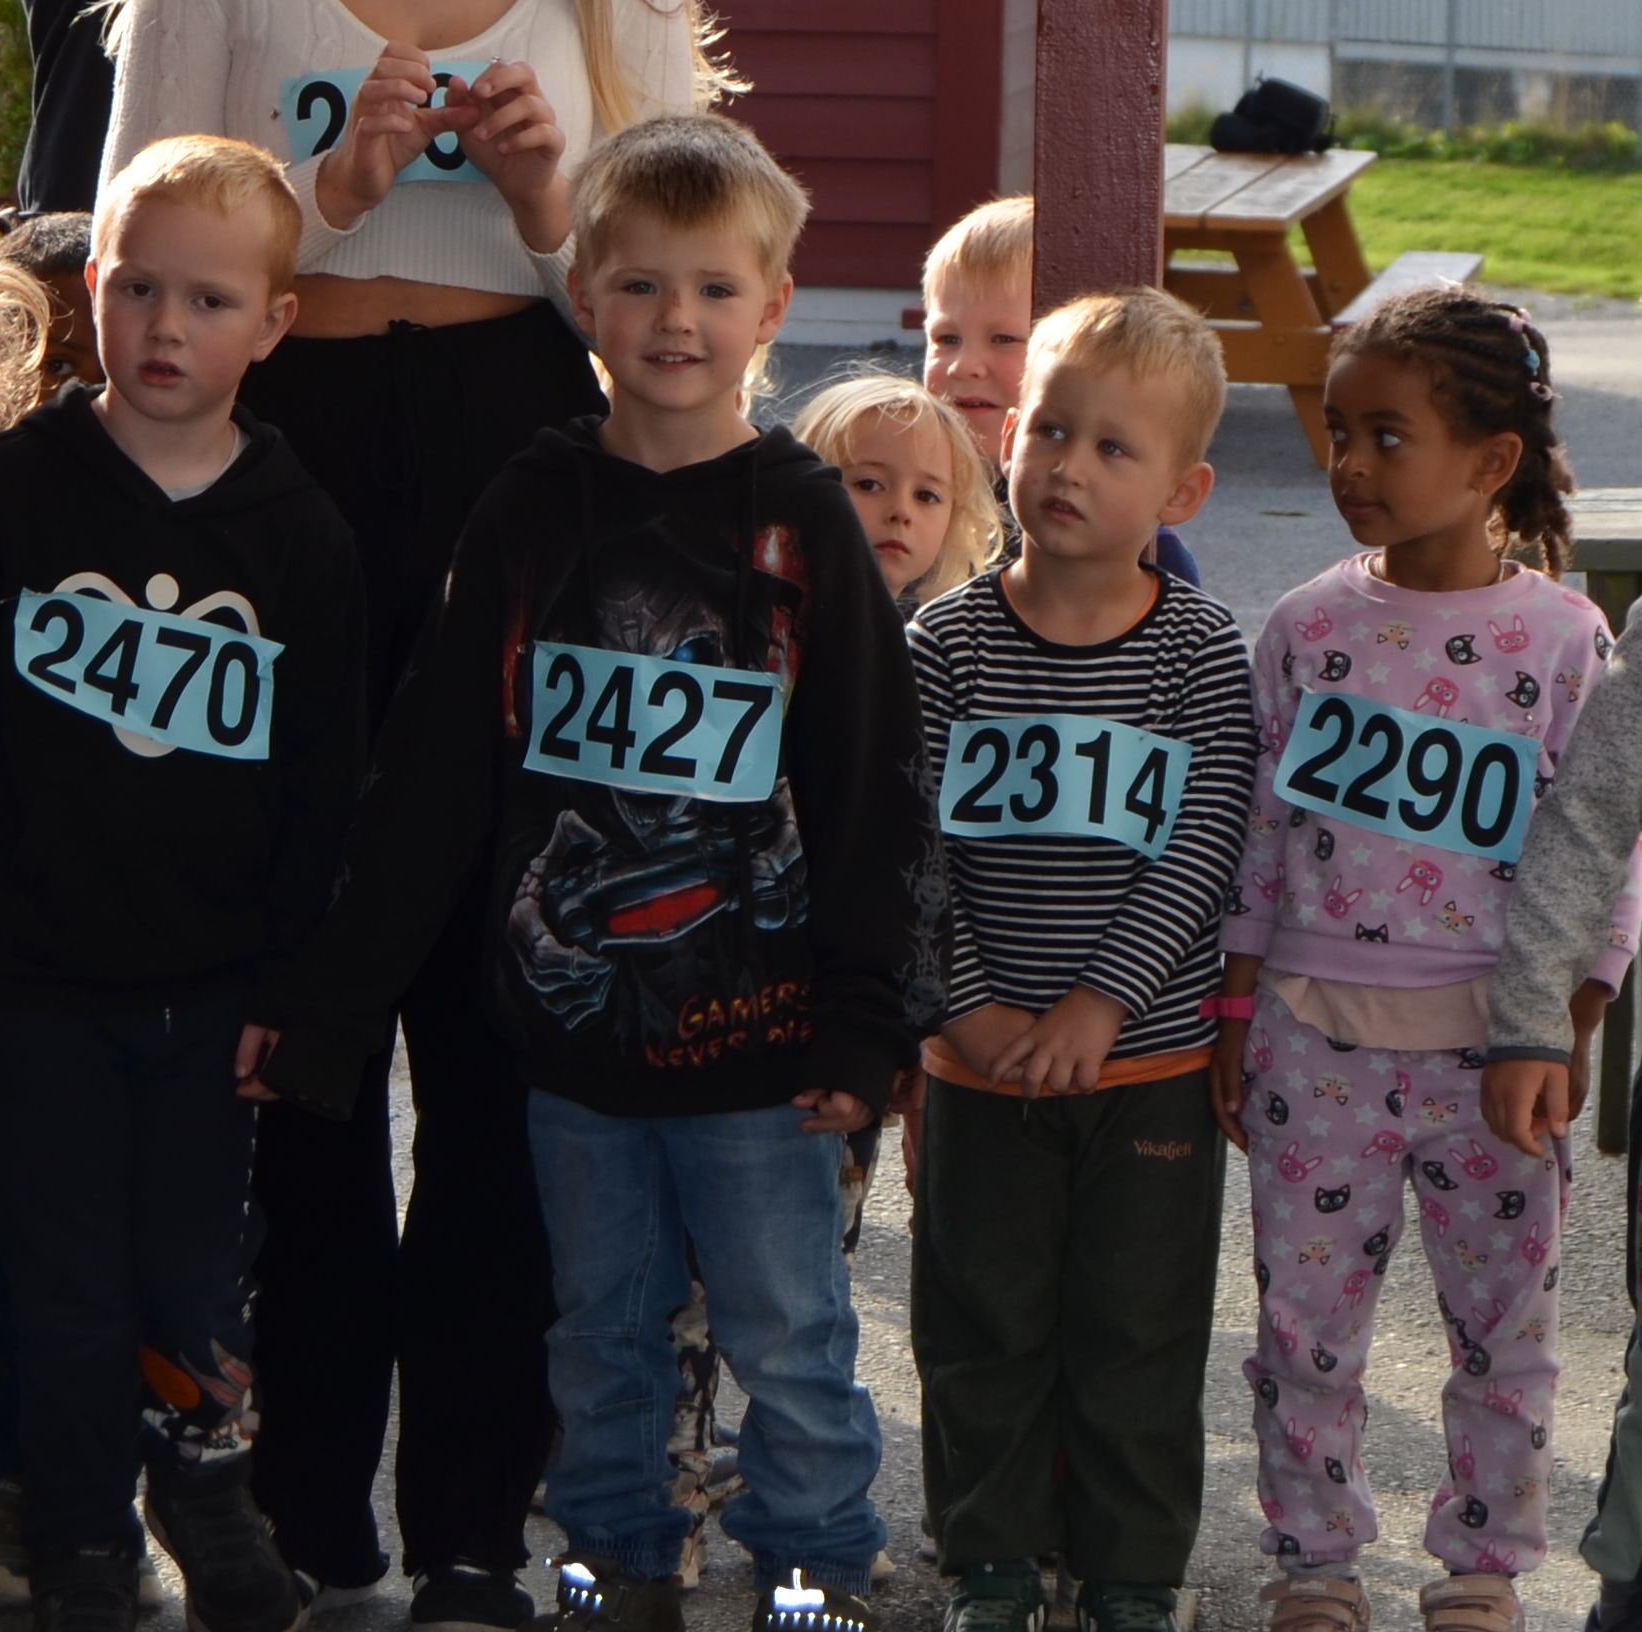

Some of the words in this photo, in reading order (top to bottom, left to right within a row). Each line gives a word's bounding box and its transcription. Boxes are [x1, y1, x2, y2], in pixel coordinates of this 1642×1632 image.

[27, 599, 260, 747] 2470
[539, 652, 774, 786] 2427
[950, 723, 1170, 844] 2314
[1286, 697, 1521, 848] 2290
[644, 1028, 750, 1068] NEVER
